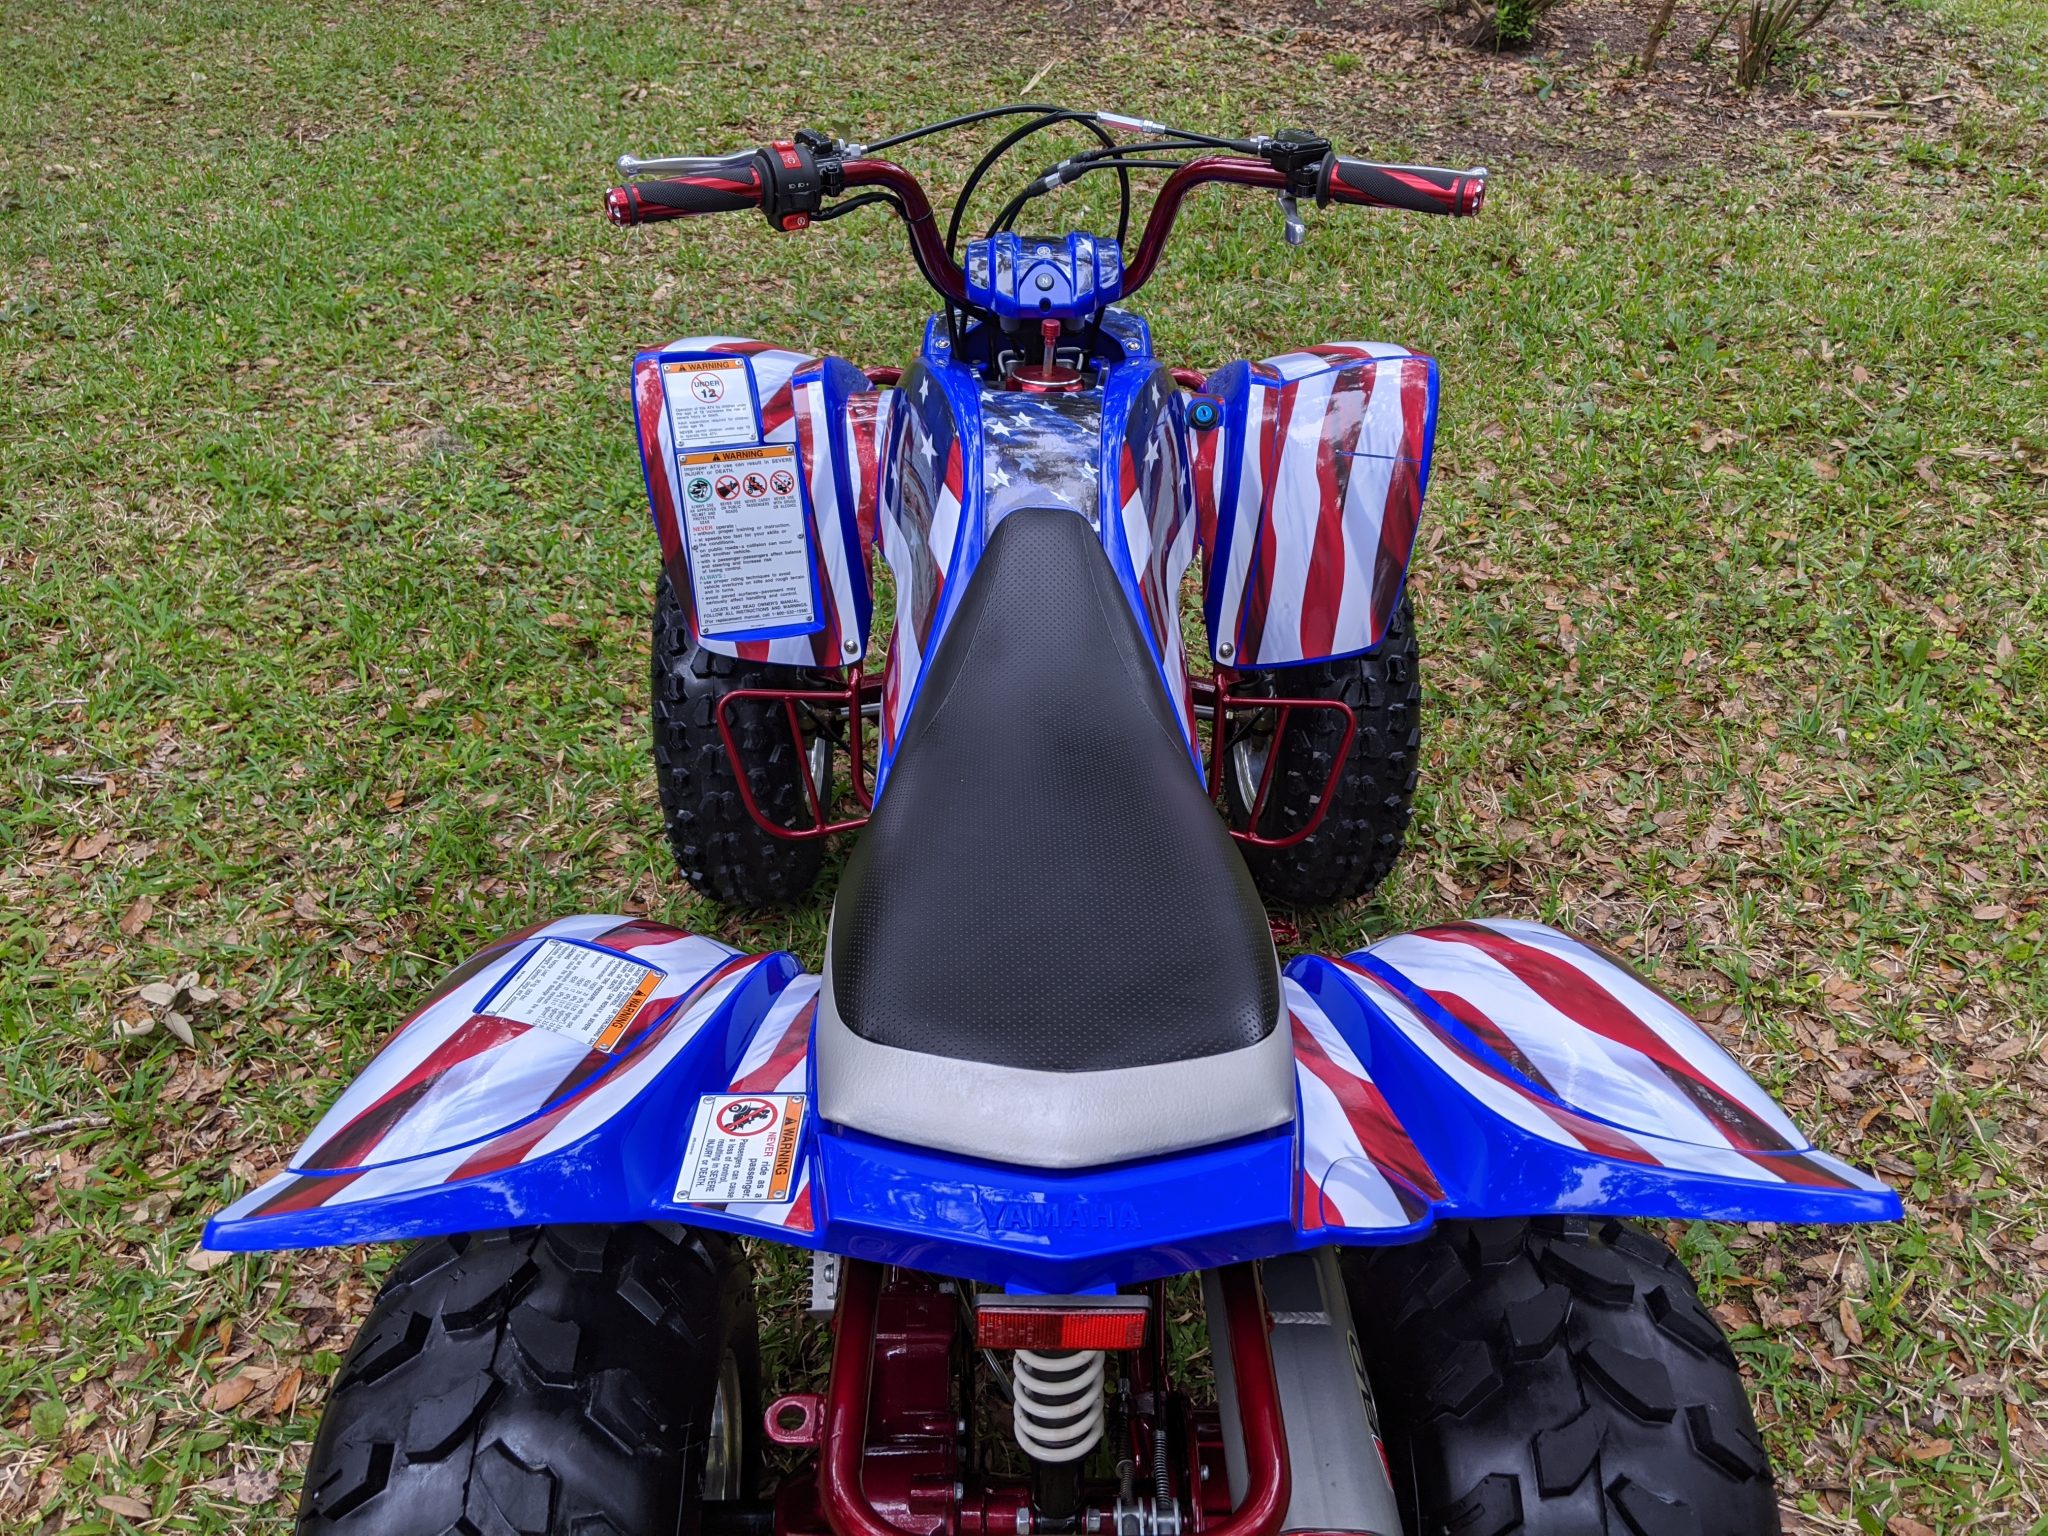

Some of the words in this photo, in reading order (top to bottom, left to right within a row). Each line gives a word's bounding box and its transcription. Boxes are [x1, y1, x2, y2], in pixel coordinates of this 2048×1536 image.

[688, 362, 729, 370] WARNING
[701, 389, 717, 398] 12
[723, 450, 763, 460] WARNING
[612, 998, 642, 1028] WARNING
[704, 1139, 715, 1157] INJURY
[712, 1139, 724, 1161] resulting
[726, 1144, 736, 1154] loss
[734, 1139, 748, 1168] Passengers
[764, 1132, 776, 1157] NEVER
[775, 1128, 794, 1175] WARNING
[696, 1168, 708, 1187] DEATH.
[760, 1161, 770, 1175] ride
[706, 1170, 718, 1192] SEVERE
[742, 1158, 757, 1198] passenger.
[757, 1180, 765, 1188] as
[727, 1182, 736, 1198] cause
[981, 1202, 1142, 1230] YAMAHA
